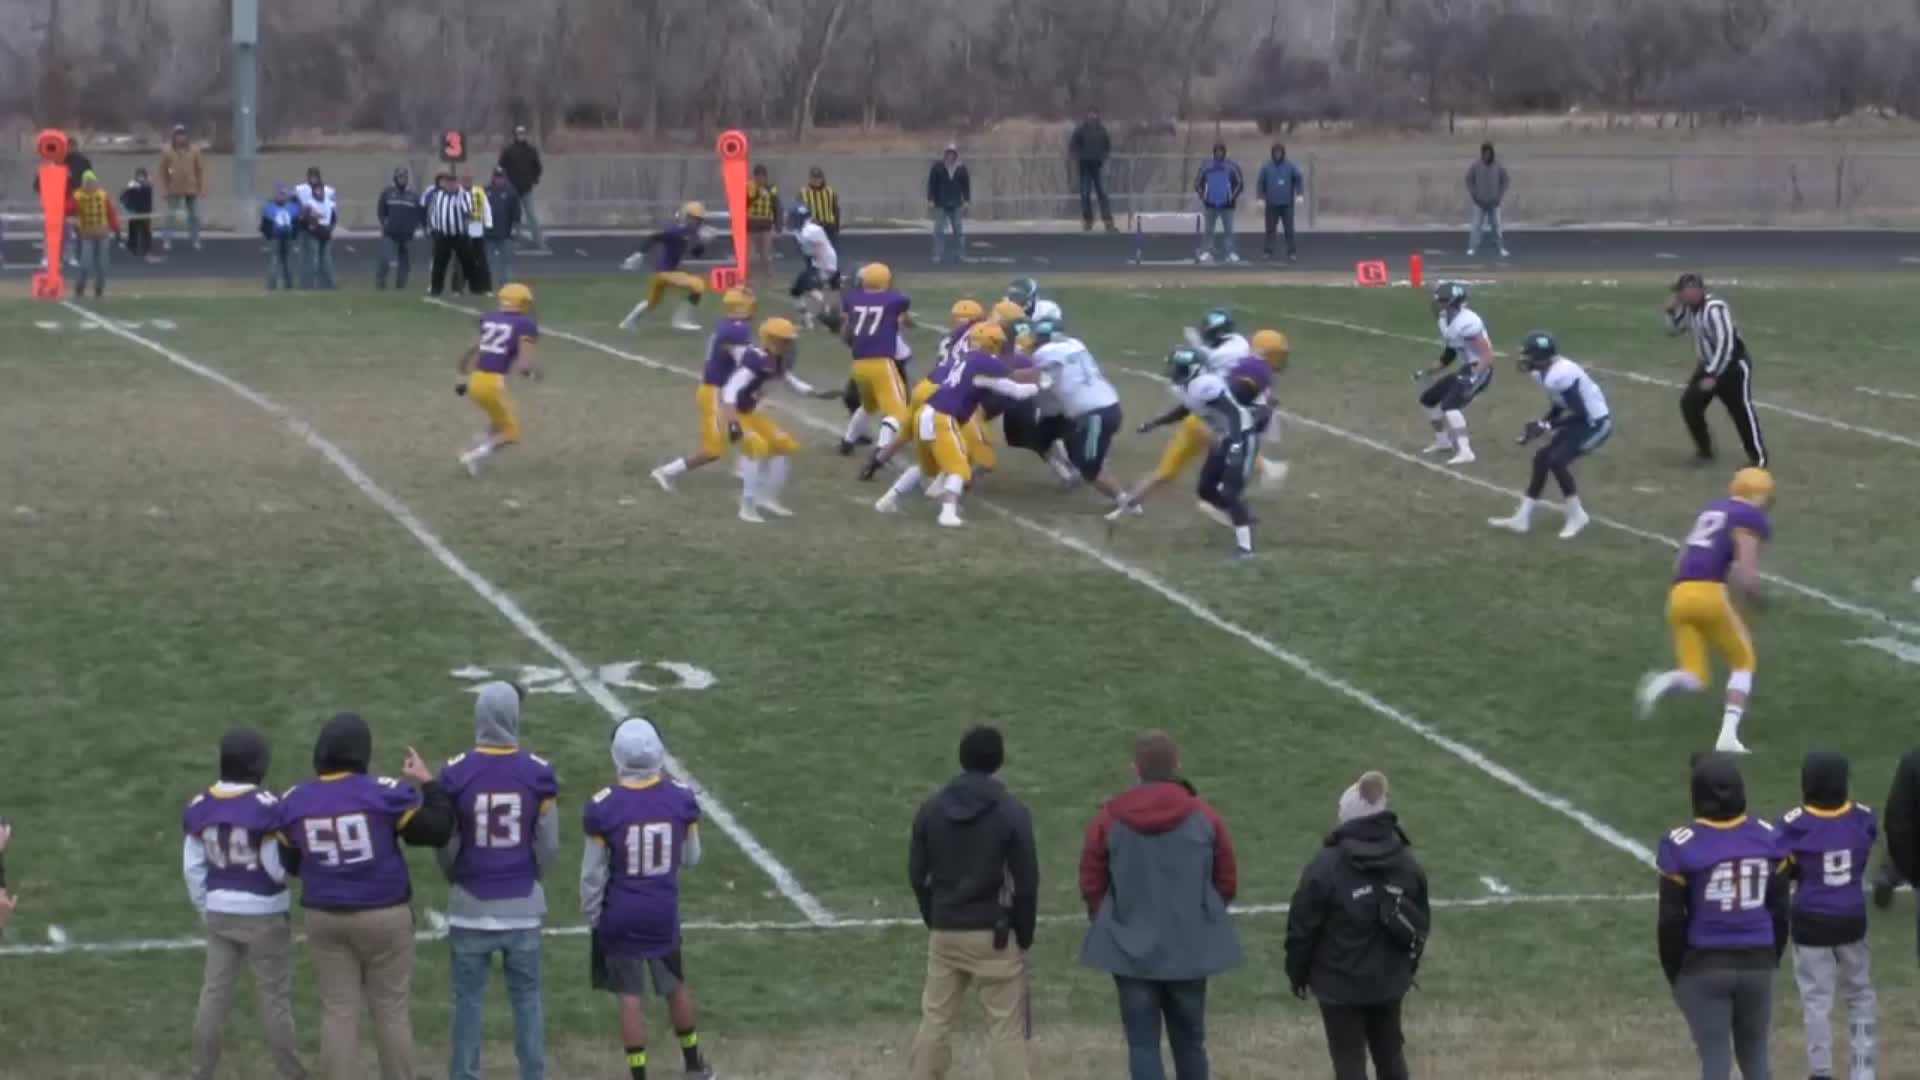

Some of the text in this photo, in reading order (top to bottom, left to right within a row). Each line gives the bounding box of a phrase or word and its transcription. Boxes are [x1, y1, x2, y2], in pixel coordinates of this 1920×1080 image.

[444, 131, 462, 158] 3
[479, 321, 512, 354] 22
[853, 305, 884, 336] 77
[304, 813, 374, 867] 59
[473, 793, 522, 848] 13
[625, 822, 673, 876] 10
[1704, 857, 1770, 911] 40
